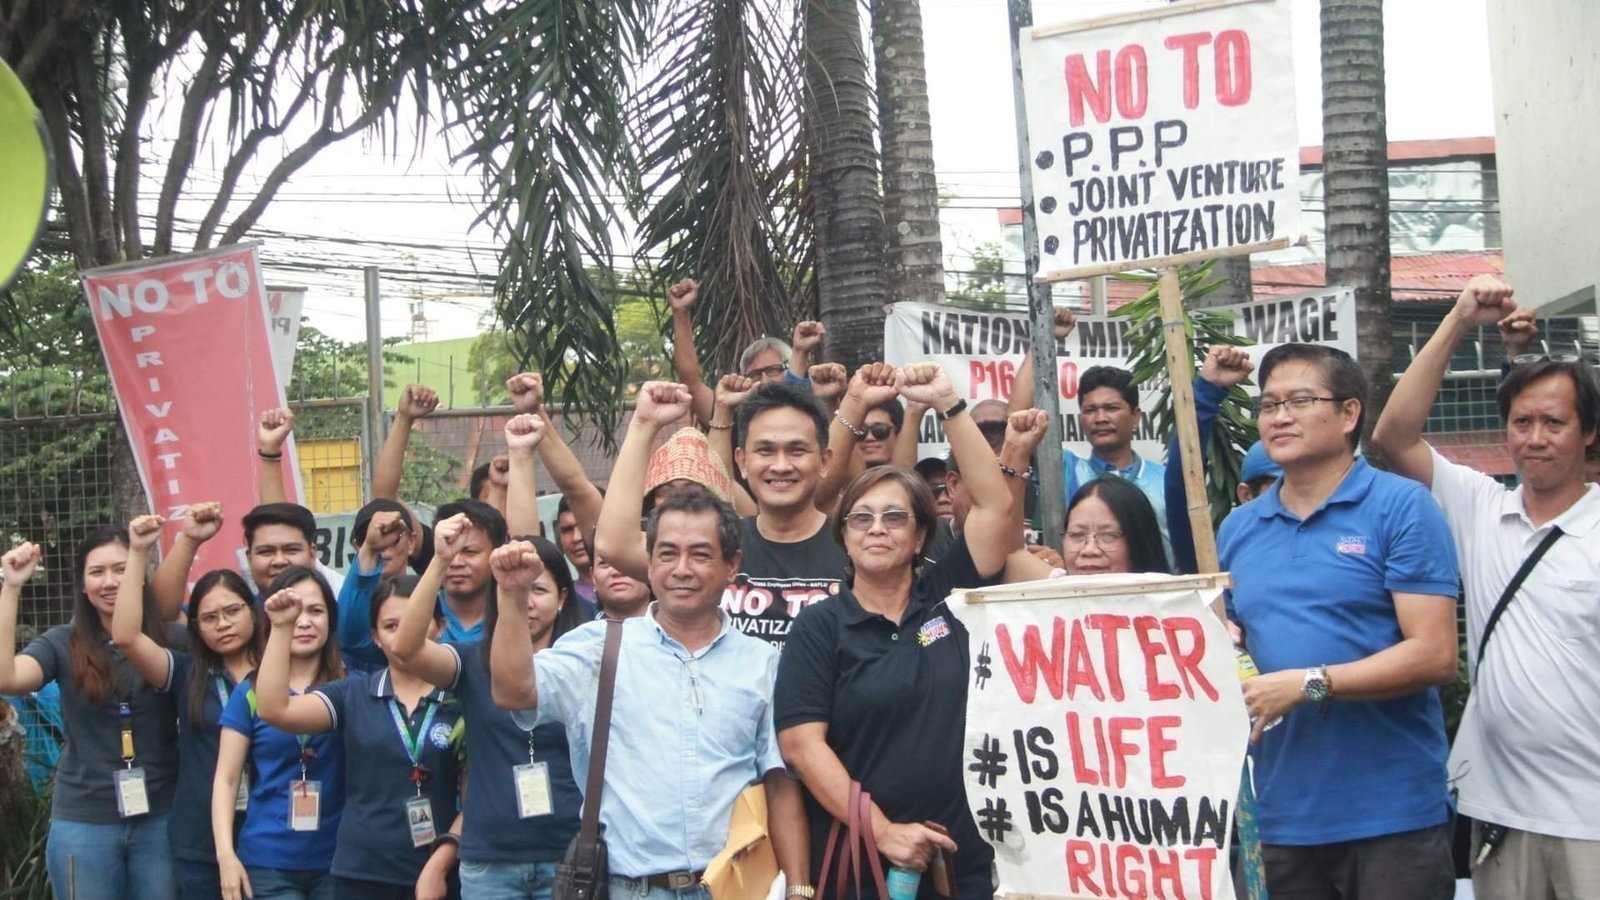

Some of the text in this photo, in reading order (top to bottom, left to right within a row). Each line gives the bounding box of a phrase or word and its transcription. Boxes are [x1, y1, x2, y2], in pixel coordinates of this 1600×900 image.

[1064, 29, 1252, 127] NO TO
[1069, 158, 1285, 216] JOINT VENTURE
[1073, 200, 1276, 264] PRIVATIZATION
[101, 260, 250, 321] NO TO
[1242, 296, 1339, 344] WAGE
[720, 585, 773, 616] NO
[1066, 712, 1187, 789] LIFE
[1065, 839, 1217, 900] RIGHT
